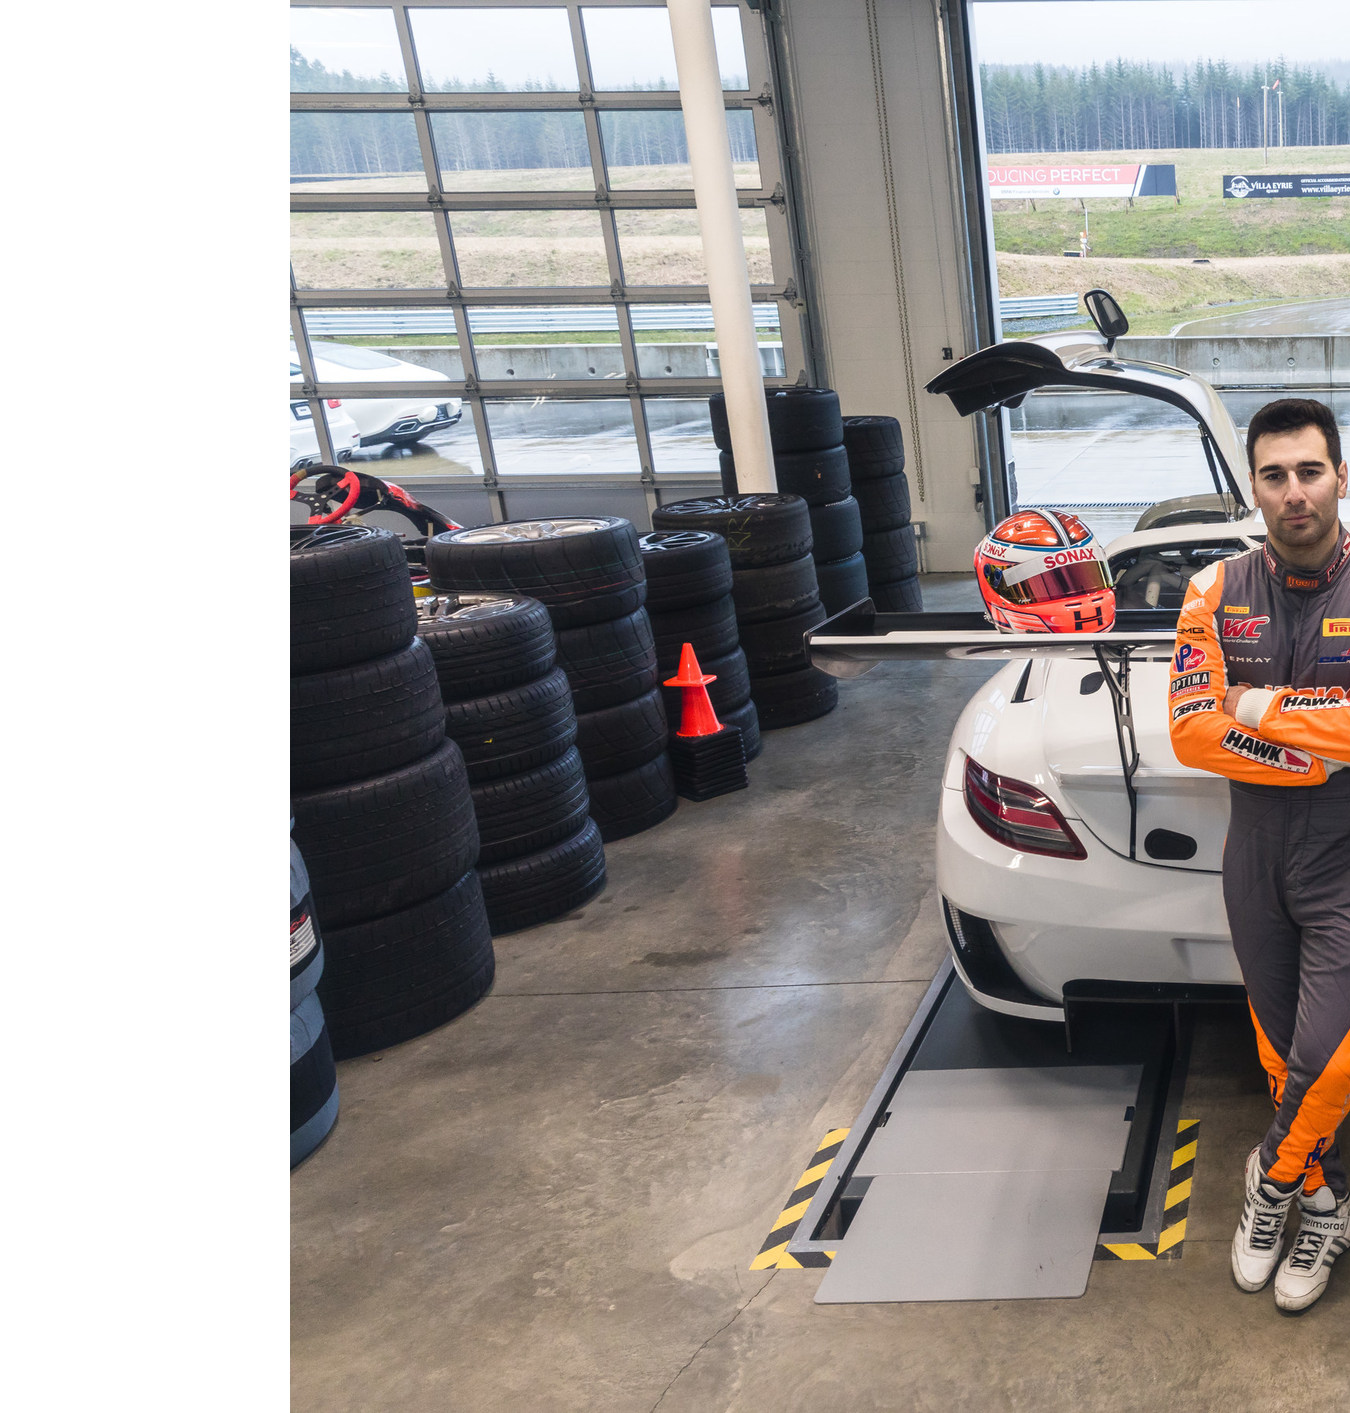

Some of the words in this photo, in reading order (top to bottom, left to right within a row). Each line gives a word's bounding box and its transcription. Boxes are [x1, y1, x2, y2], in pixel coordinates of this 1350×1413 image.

[1050, 168, 1120, 182] PERFECT
[1251, 181, 1272, 190] VILLA
[1272, 182, 1293, 190] EYRIE
[1043, 548, 1097, 569] SONAX
[1171, 673, 1208, 693] OPTIMA
[1283, 695, 1341, 708] HAWK
[1225, 729, 1285, 763] HAWK
